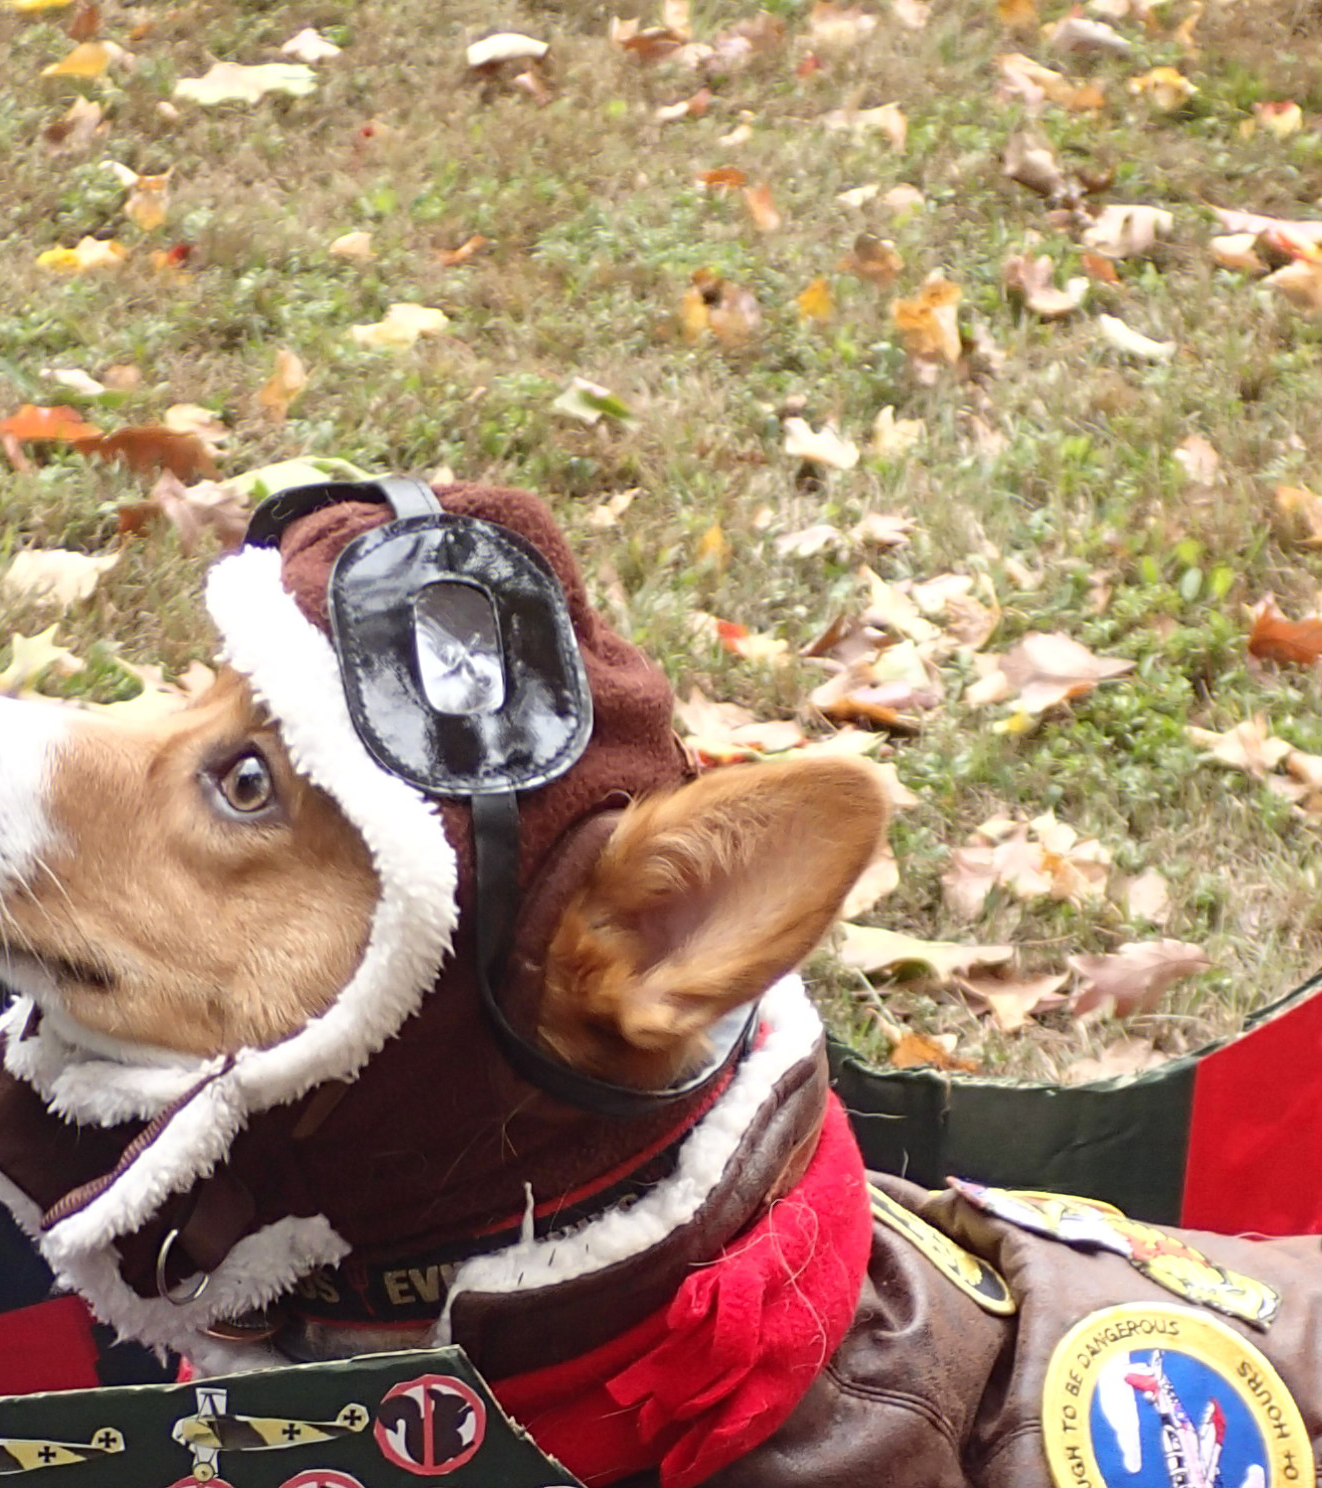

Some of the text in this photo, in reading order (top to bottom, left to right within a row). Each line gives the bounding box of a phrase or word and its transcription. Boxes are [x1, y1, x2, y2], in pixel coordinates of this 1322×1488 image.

[1076, 1318, 1181, 1370] DANGEROUS
[1064, 1373, 1085, 1398] BE
[1236, 1360, 1291, 1440] HOURS
[1061, 1404, 1078, 1434] TO
